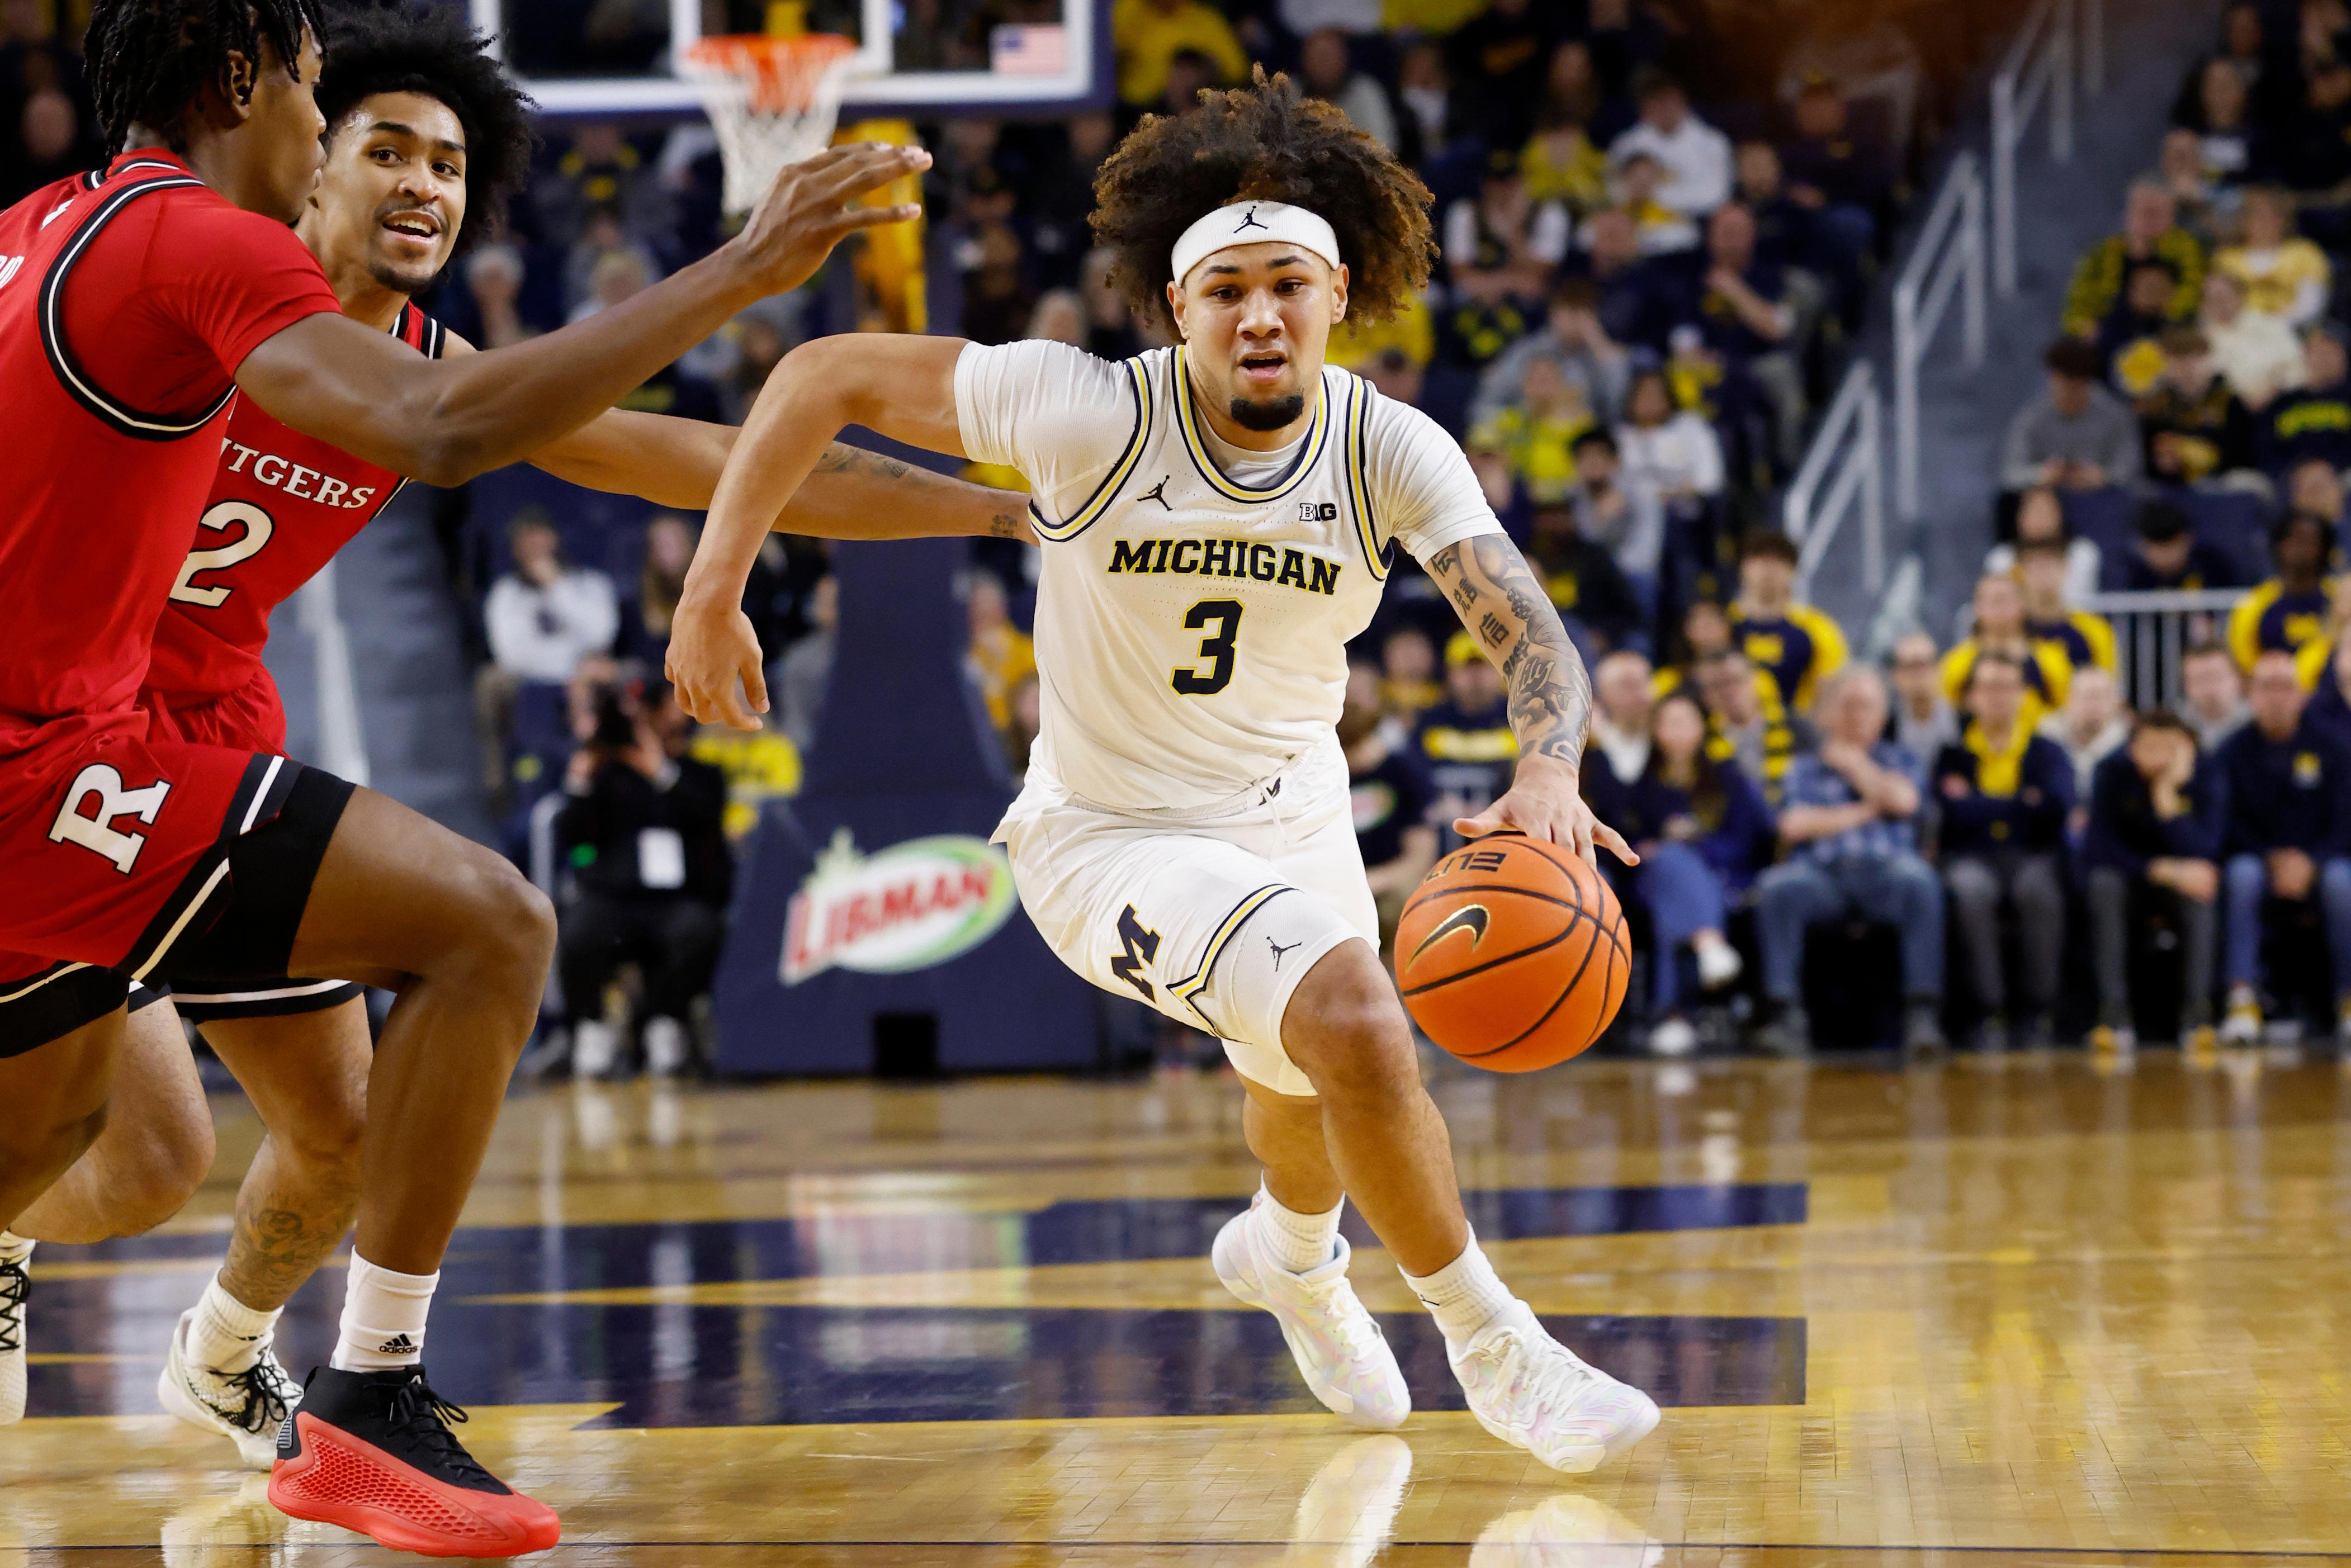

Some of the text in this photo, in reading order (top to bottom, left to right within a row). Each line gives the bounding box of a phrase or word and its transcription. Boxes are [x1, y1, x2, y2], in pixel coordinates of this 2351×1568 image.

[220, 437, 376, 510] TGERS
[167, 498, 276, 609] 2
[1107, 538, 1342, 595] MICHIGAN
[1169, 597, 1245, 697] 3
[47, 761, 173, 878] R
[1425, 851, 1507, 883] ELIT
[784, 864, 995, 973] LIBMAN
[1110, 901, 1163, 1005] M
[379, 1344, 418, 1354] adidas
